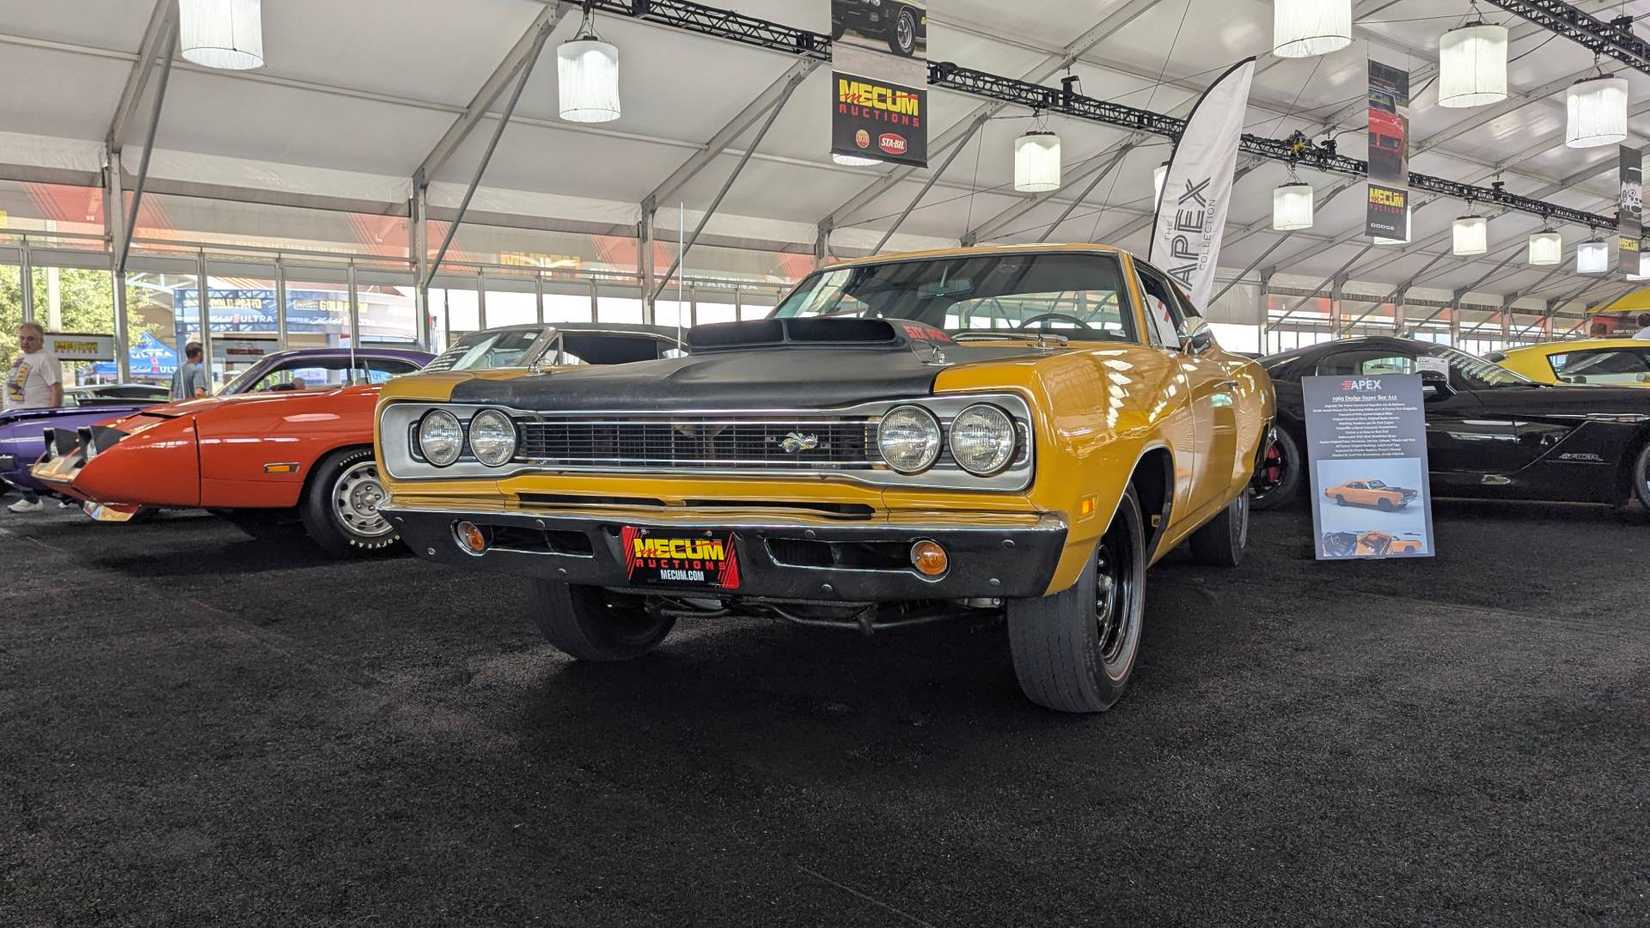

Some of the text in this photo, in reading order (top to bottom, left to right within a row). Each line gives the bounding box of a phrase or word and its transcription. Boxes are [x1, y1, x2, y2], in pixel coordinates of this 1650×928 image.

[839, 79, 919, 116] MECUM
[838, 104, 920, 128] AUCTIONS
[1369, 187, 1404, 208] MECUM
[1164, 223, 1174, 241] THE
[1167, 176, 1212, 292] APEX
[1198, 199, 1217, 271] COLLECTION
[240, 314, 274, 323] ULTRA
[1350, 379, 1382, 391] APEX
[633, 538, 725, 561] MECUM
[635, 559, 727, 571] AUCTIONS
[660, 569, 705, 581] MECUM.COM
